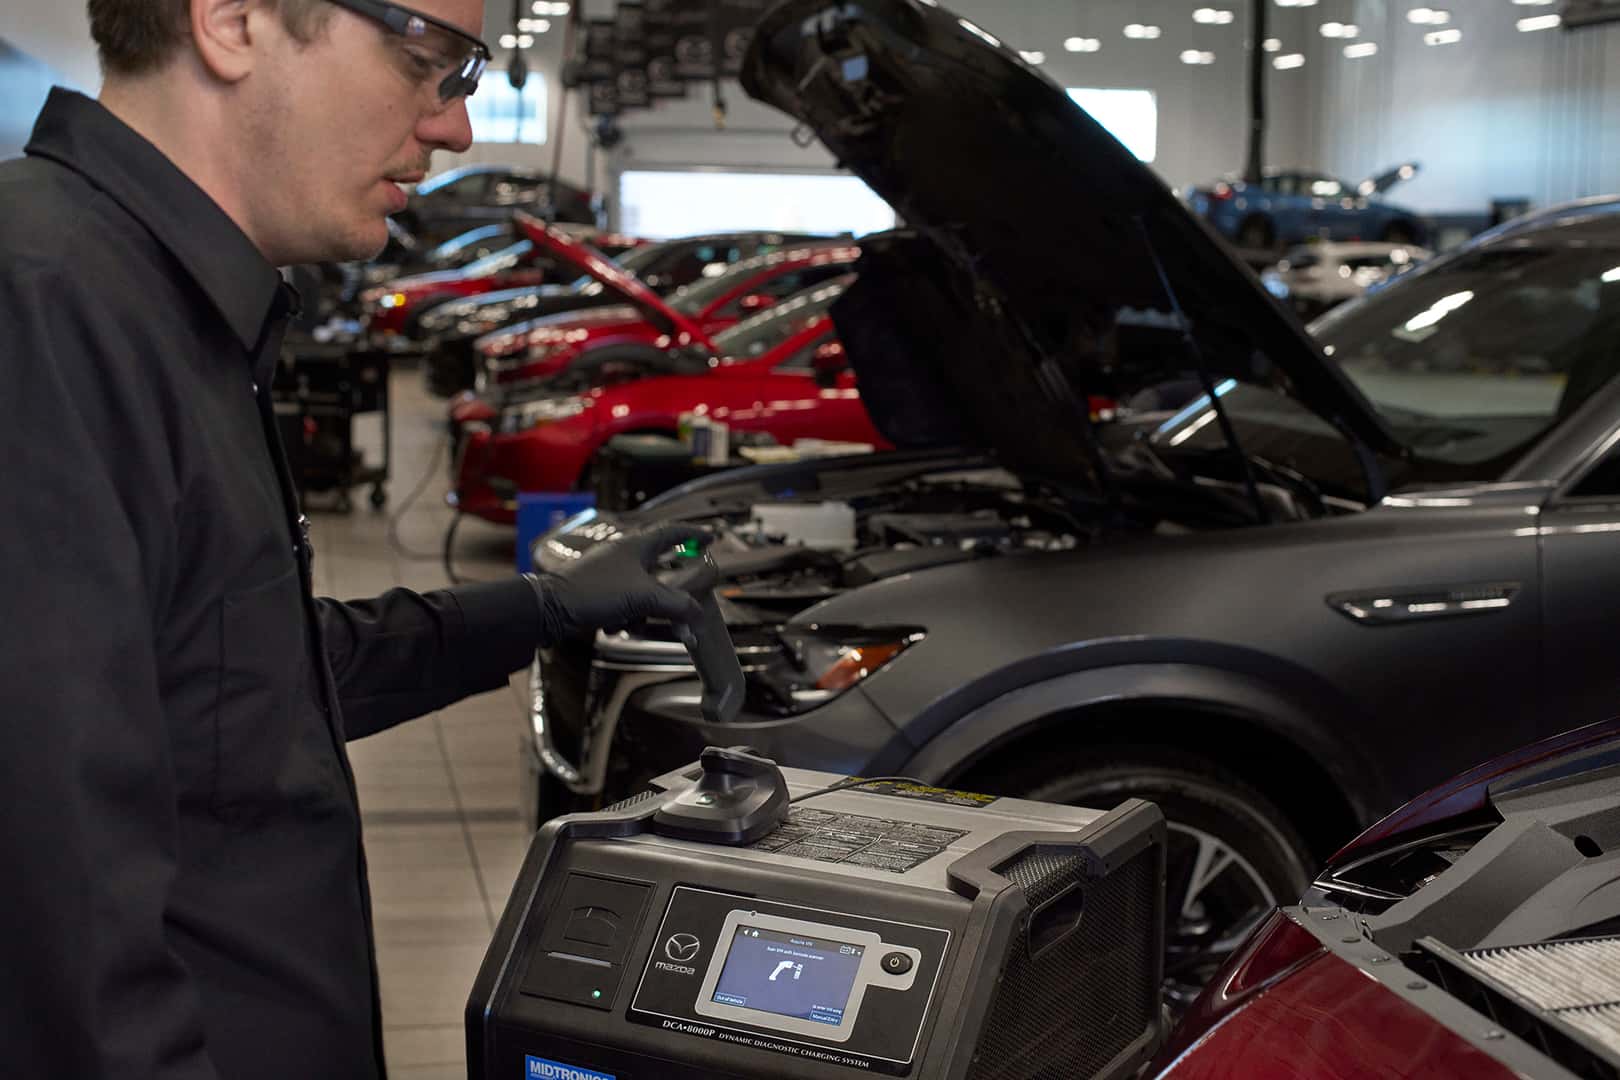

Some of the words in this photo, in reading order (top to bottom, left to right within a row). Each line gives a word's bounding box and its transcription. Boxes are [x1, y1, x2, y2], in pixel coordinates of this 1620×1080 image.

[655, 961, 695, 975] mazda
[718, 1033, 753, 1045] DYNAMIC
[754, 1039, 799, 1055] DIAGNOSTIC
[800, 1048, 841, 1062] CHARGING
[842, 1057, 869, 1068] SYSTEM
[530, 1060, 609, 1080] MIDTRONI
